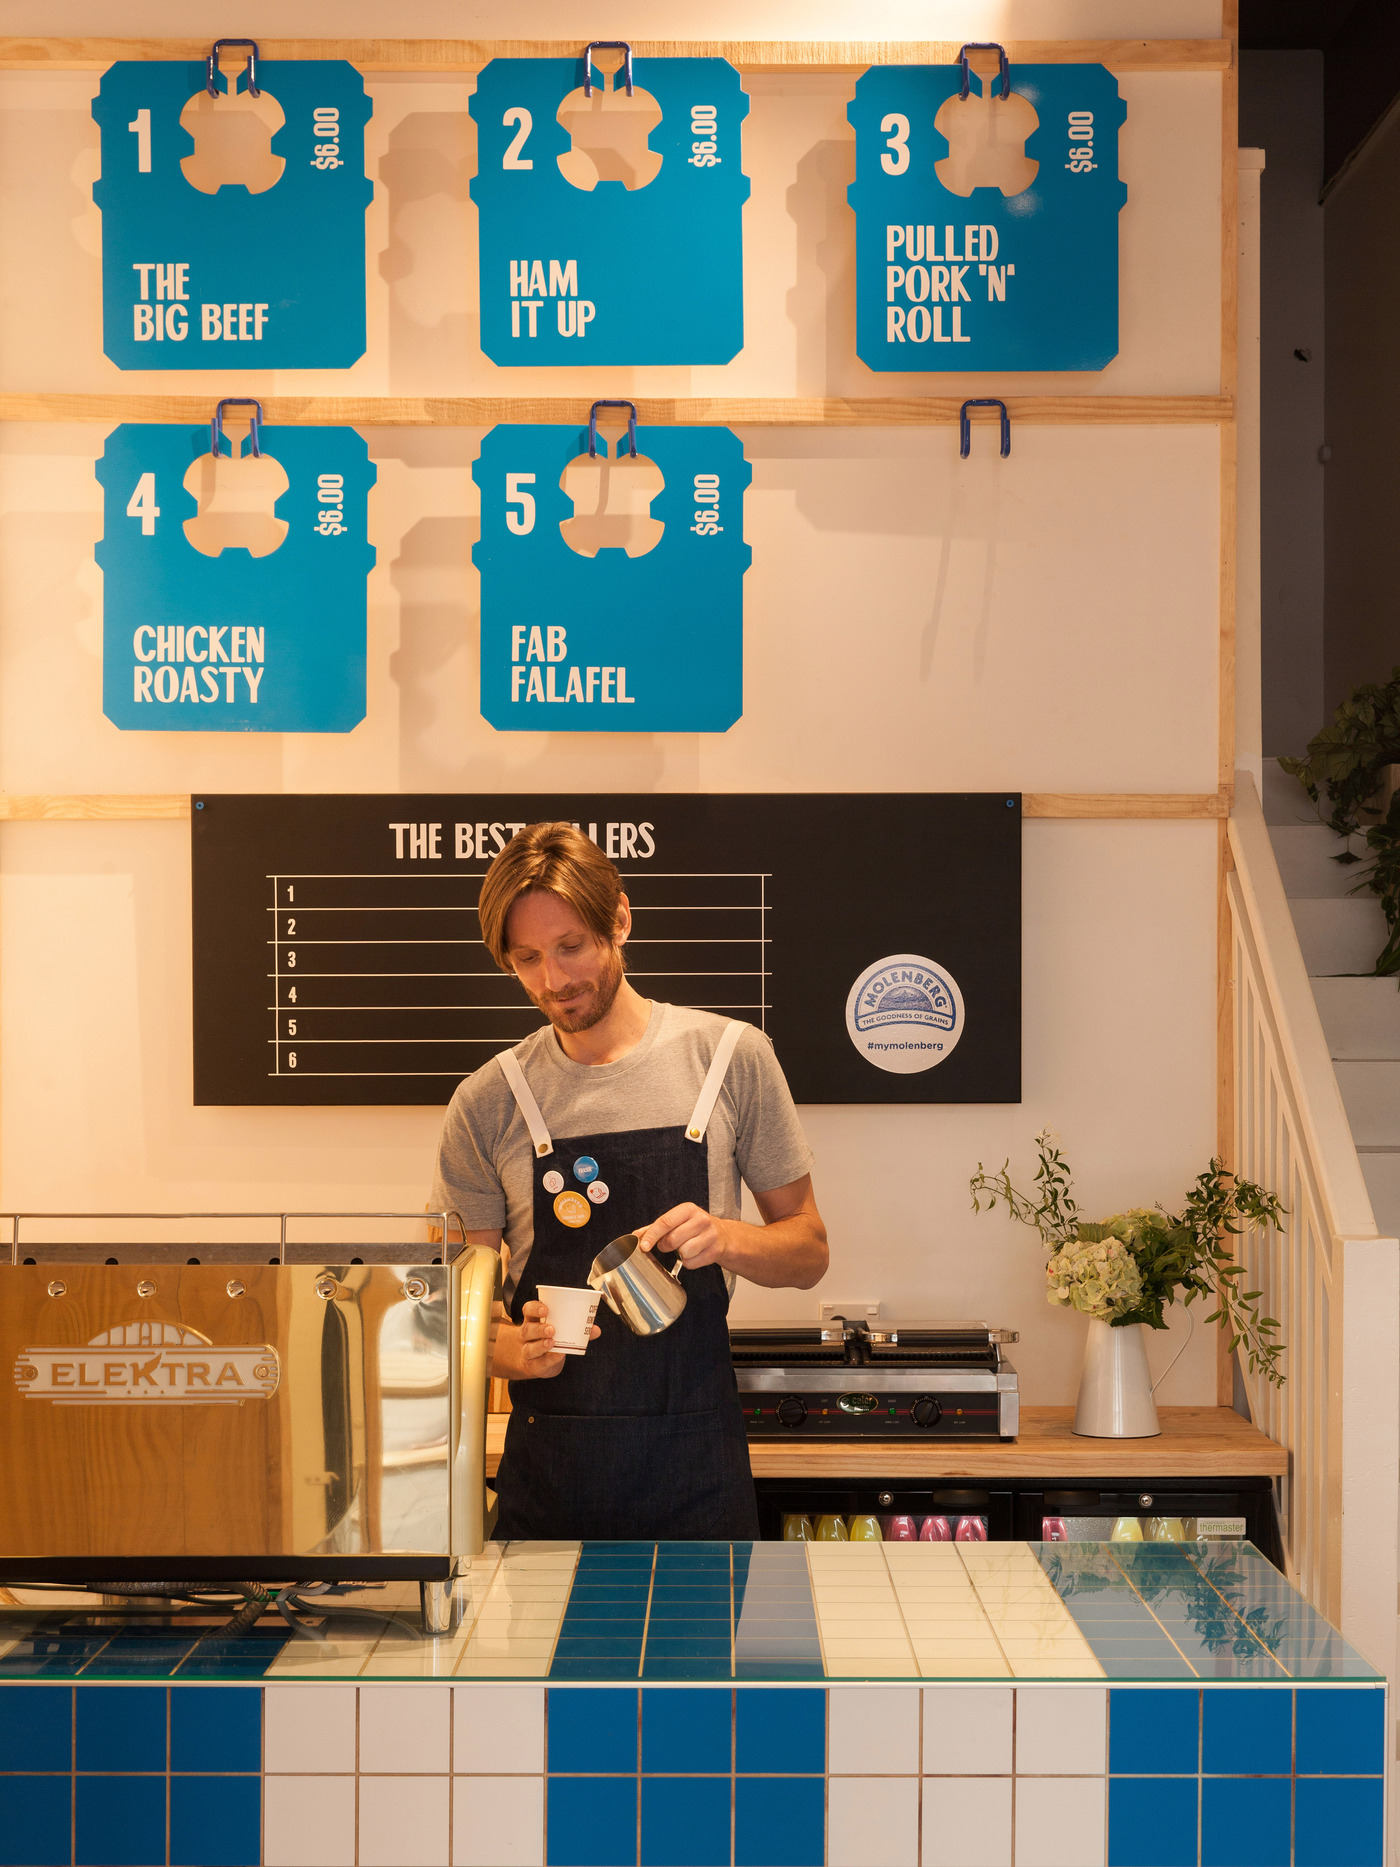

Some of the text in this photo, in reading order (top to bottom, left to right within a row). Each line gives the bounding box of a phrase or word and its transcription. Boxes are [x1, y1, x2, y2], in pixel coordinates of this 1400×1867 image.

[128, 108, 152, 173] 1
[310, 107, 344, 170] $6.00
[502, 106, 534, 170] 2
[687, 105, 722, 168] $6.00
[880, 112, 911, 176] 3
[1064, 111, 1098, 173] $6.00
[886, 224, 999, 262] PULLED
[133, 263, 190, 301] THE
[509, 259, 578, 297] HAM
[886, 265, 972, 303] PORK
[133, 303, 269, 342] BIG BEEF
[511, 300, 596, 338] IT UP
[886, 305, 971, 343] ROLL
[126, 472, 161, 536] 4
[313, 473, 348, 536] $6.00
[505, 472, 536, 536] 5
[689, 473, 724, 536] $6.00
[133, 624, 265, 663] CHICKEN
[511, 625, 568, 663] FAB
[133, 665, 265, 704] ROASTY
[511, 665, 636, 704] FALAFEL
[388, 822, 443, 859] THE
[286, 885, 294, 902] 1
[287, 918, 296, 936] 2
[287, 950, 297, 968] 3
[288, 986, 298, 1003] 4
[864, 970, 947, 1008] MOLENBERG
[288, 1019, 297, 1036] 5
[862, 1017, 875, 1026] THE
[876, 1013, 912, 1022] GOODNESS
[924, 1014, 949, 1026] GRAINS
[288, 1051, 297, 1069] 6
[867, 1041, 944, 1051] #mymolenberg
[51, 1356, 246, 1386] ELEKTRA
[1199, 1522, 1244, 1532] thermaster
